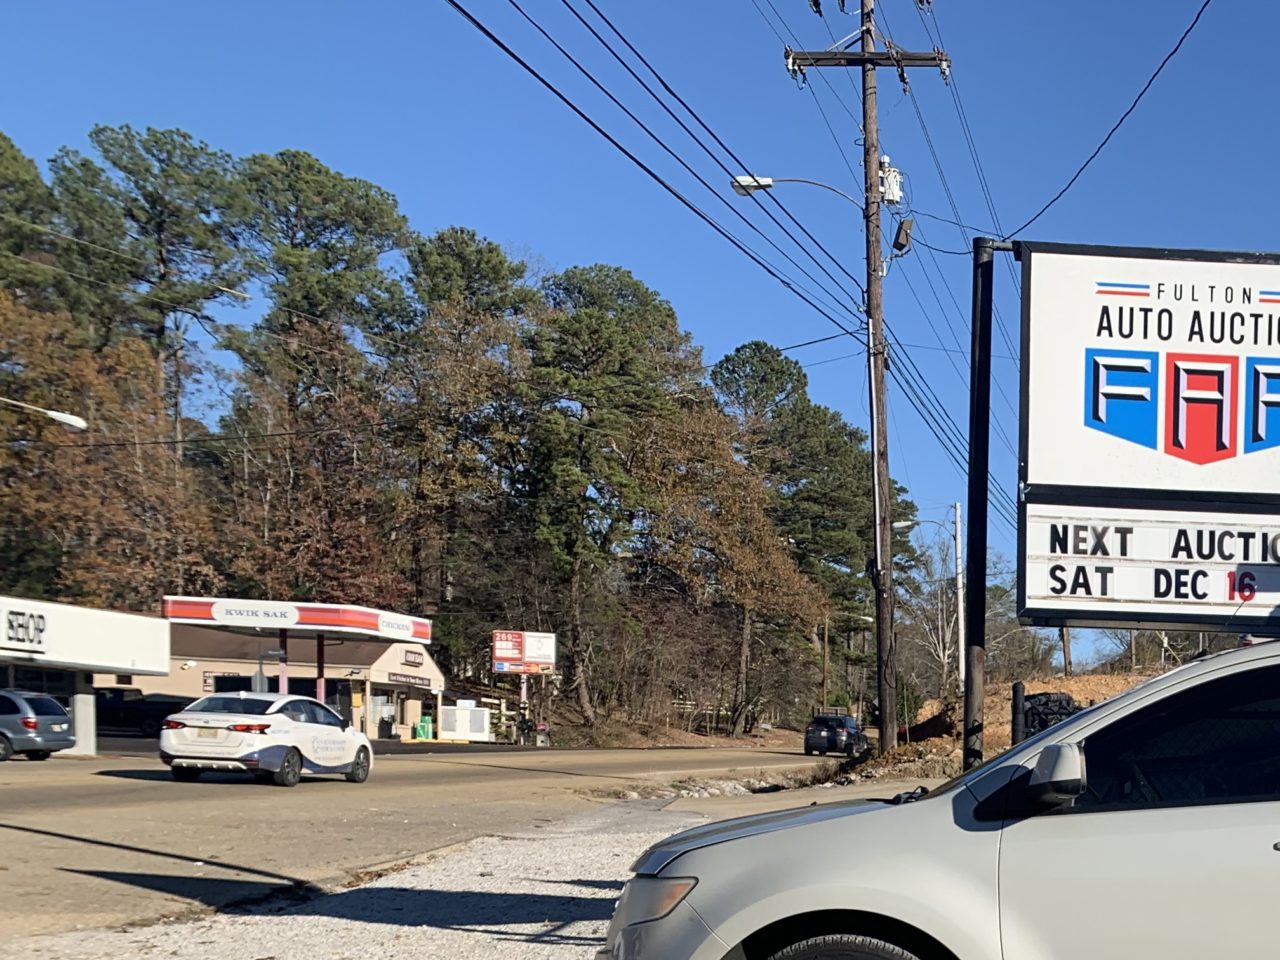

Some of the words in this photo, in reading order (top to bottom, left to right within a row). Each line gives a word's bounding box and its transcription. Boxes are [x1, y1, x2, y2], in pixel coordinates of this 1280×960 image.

[1157, 283, 1252, 305] FULTON
[1096, 305, 1173, 341] AUTO
[1049, 523, 1134, 557] NEXT
[1049, 564, 1114, 596] SAT
[1154, 568, 1209, 600] DEC
[1227, 571, 1256, 602] 16
[225, 608, 259, 617] KWIK
[263, 610, 289, 618] SAK
